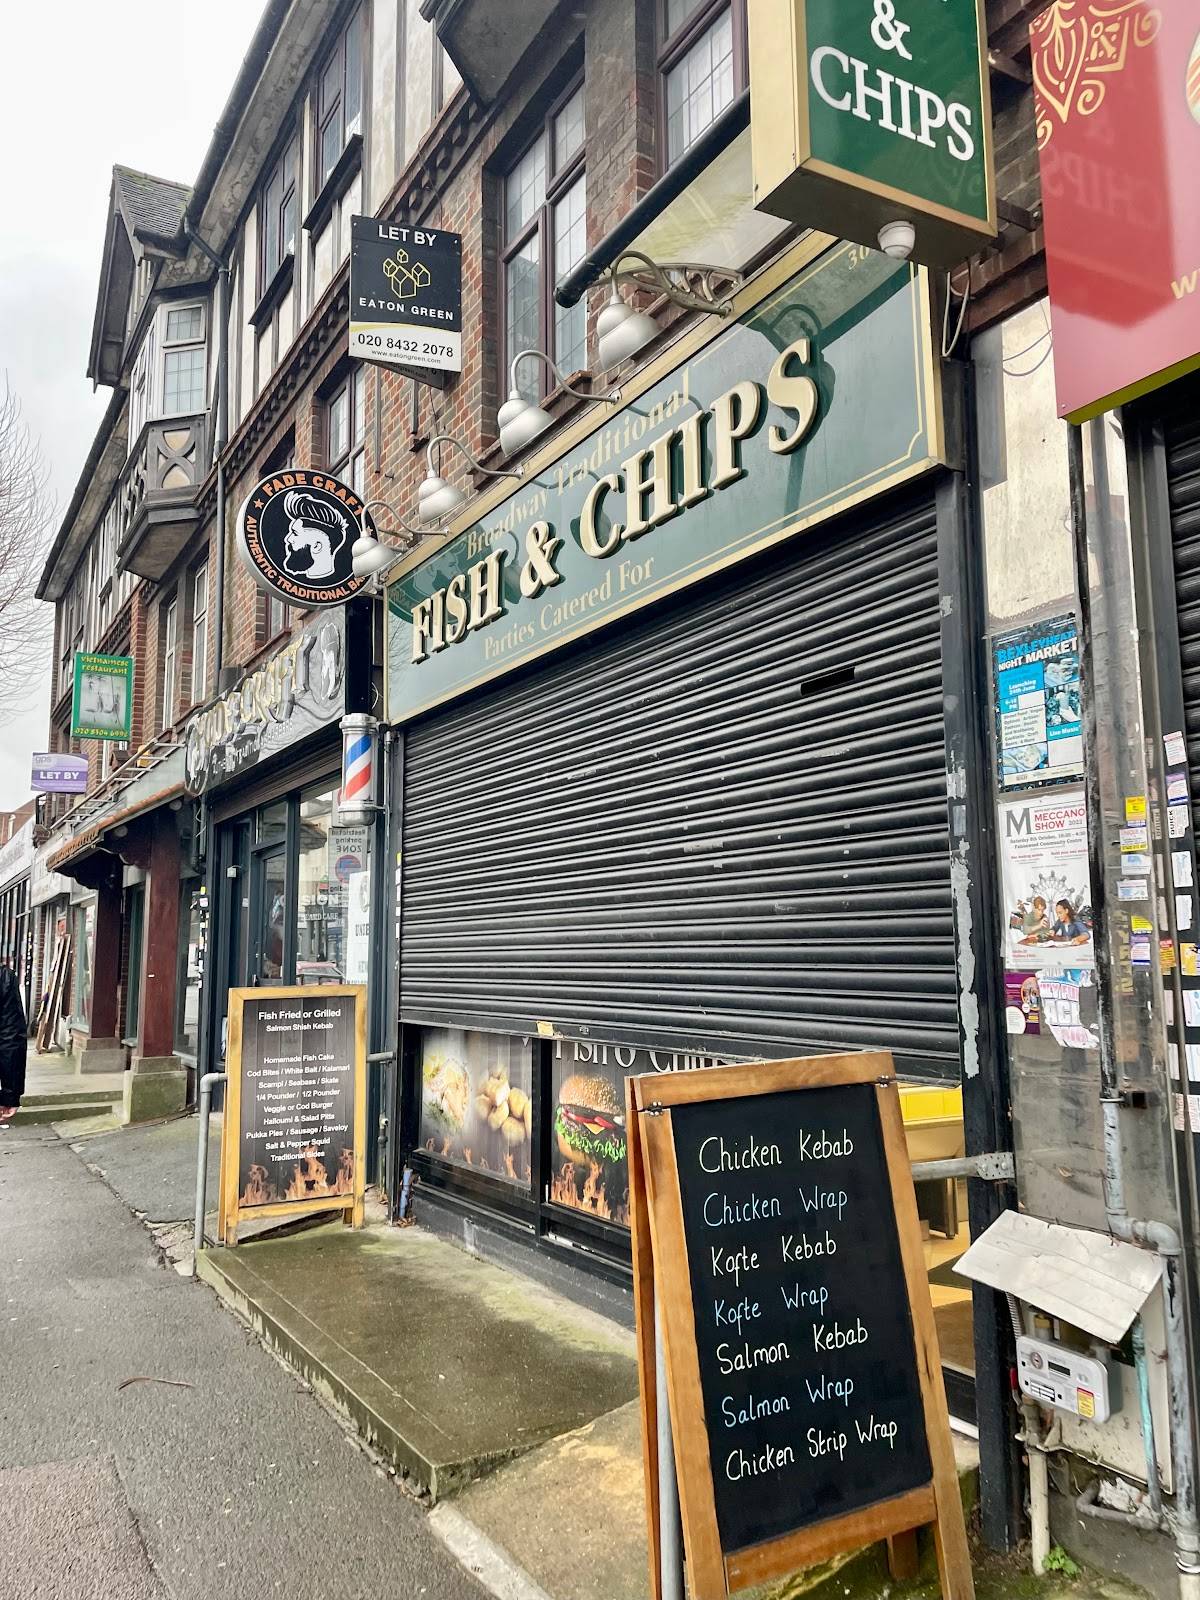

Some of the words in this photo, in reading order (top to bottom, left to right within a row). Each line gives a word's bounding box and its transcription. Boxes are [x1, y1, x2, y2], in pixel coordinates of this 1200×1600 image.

[871, 0, 912, 60] &
[811, 45, 974, 161] CHIPS
[379, 225, 410, 242] LET
[414, 231, 437, 247] BY
[359, 297, 405, 313] EATON
[411, 305, 454, 321] GREEN
[358, 333, 382, 347] 020
[387, 338, 418, 352] 8432
[423, 343, 454, 358] 2078
[371, 350, 441, 364] www.eatongreen.com
[553, 366, 691, 496] Traditional
[262, 473, 307, 497] FADE
[312, 475, 364, 516] CRAFT
[411, 550, 507, 664] FISH
[520, 520, 560, 598] &
[579, 338, 819, 559] CHIPS
[246, 515, 278, 579] AUTHENTIC
[277, 576, 350, 601] TRADITIONAL
[484, 620, 534, 660] Parties
[540, 569, 612, 630] Catered
[619, 556, 655, 592] For
[998, 656, 1023, 671] NIGHT
[1025, 637, 1077, 663] MARKET
[39, 771, 61, 780] LET
[63, 771, 79, 780] BY
[1006, 808, 1032, 837] M
[1034, 808, 1086, 822] MECCANO
[1035, 820, 1065, 831] SHOW
[258, 1011, 278, 1020] Fish
[279, 1010, 301, 1019] Fried
[313, 1009, 341, 1018] Grilled
[292, 1023, 312, 1031] Shish
[312, 1022, 334, 1030] Kebab
[263, 1056, 302, 1064] Homemade
[284, 1067, 303, 1075] White
[322, 1064, 350, 1073] Kalamari
[258, 1081, 284, 1089] Scampi
[267, 1092, 296, 1100] Pounder
[312, 1088, 341, 1096] Pounder
[263, 1105, 286, 1114] Veggie
[311, 1102, 333, 1110] Burger
[263, 1116, 293, 1125] Halloumi
[301, 1113, 320, 1122] Salad
[246, 1131, 267, 1139] Pukka
[269, 1130, 283, 1138] Pies
[290, 1127, 318, 1135] Sausage
[323, 1124, 348, 1132] Saveloy
[287, 1140, 310, 1148] Pepper
[311, 1137, 331, 1145] Squid
[270, 1153, 306, 1162] Traditional
[699, 1135, 782, 1173] Chicken
[799, 1128, 854, 1162] Kebab
[703, 1193, 782, 1227] Chicken
[799, 1185, 848, 1221] Wrap
[711, 1245, 760, 1287] Kofte
[781, 1230, 837, 1263] Kebab
[714, 1296, 762, 1336] Kofte
[780, 1282, 829, 1316] Wrap
[716, 1342, 790, 1375] Salmon
[812, 1317, 868, 1352] Kebab
[721, 1395, 790, 1428] Salmon
[805, 1374, 854, 1407] Wrap
[726, 1444, 795, 1481] Chicken
[806, 1427, 848, 1461] Strip
[855, 1414, 898, 1449] Wrap
